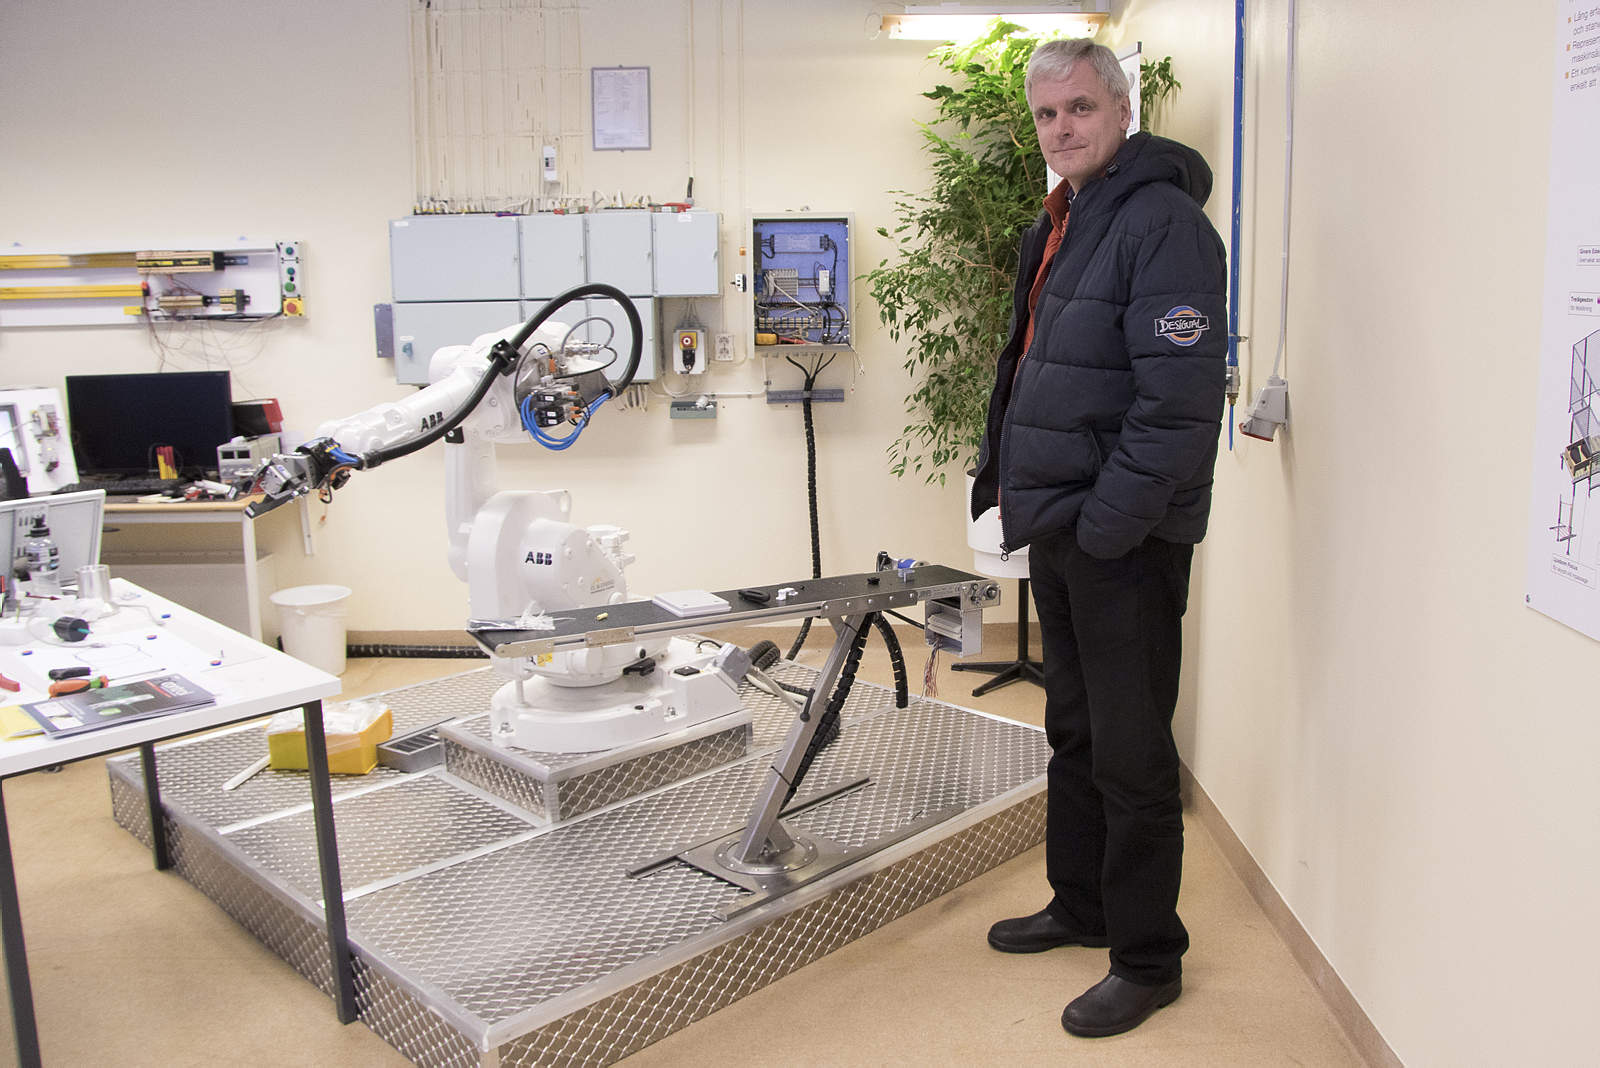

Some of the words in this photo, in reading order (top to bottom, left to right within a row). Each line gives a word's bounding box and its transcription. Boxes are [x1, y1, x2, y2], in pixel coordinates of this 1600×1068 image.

[1573, 25, 1584, 35] och
[420, 411, 444, 432] ABB
[525, 551, 553, 566] ABB
